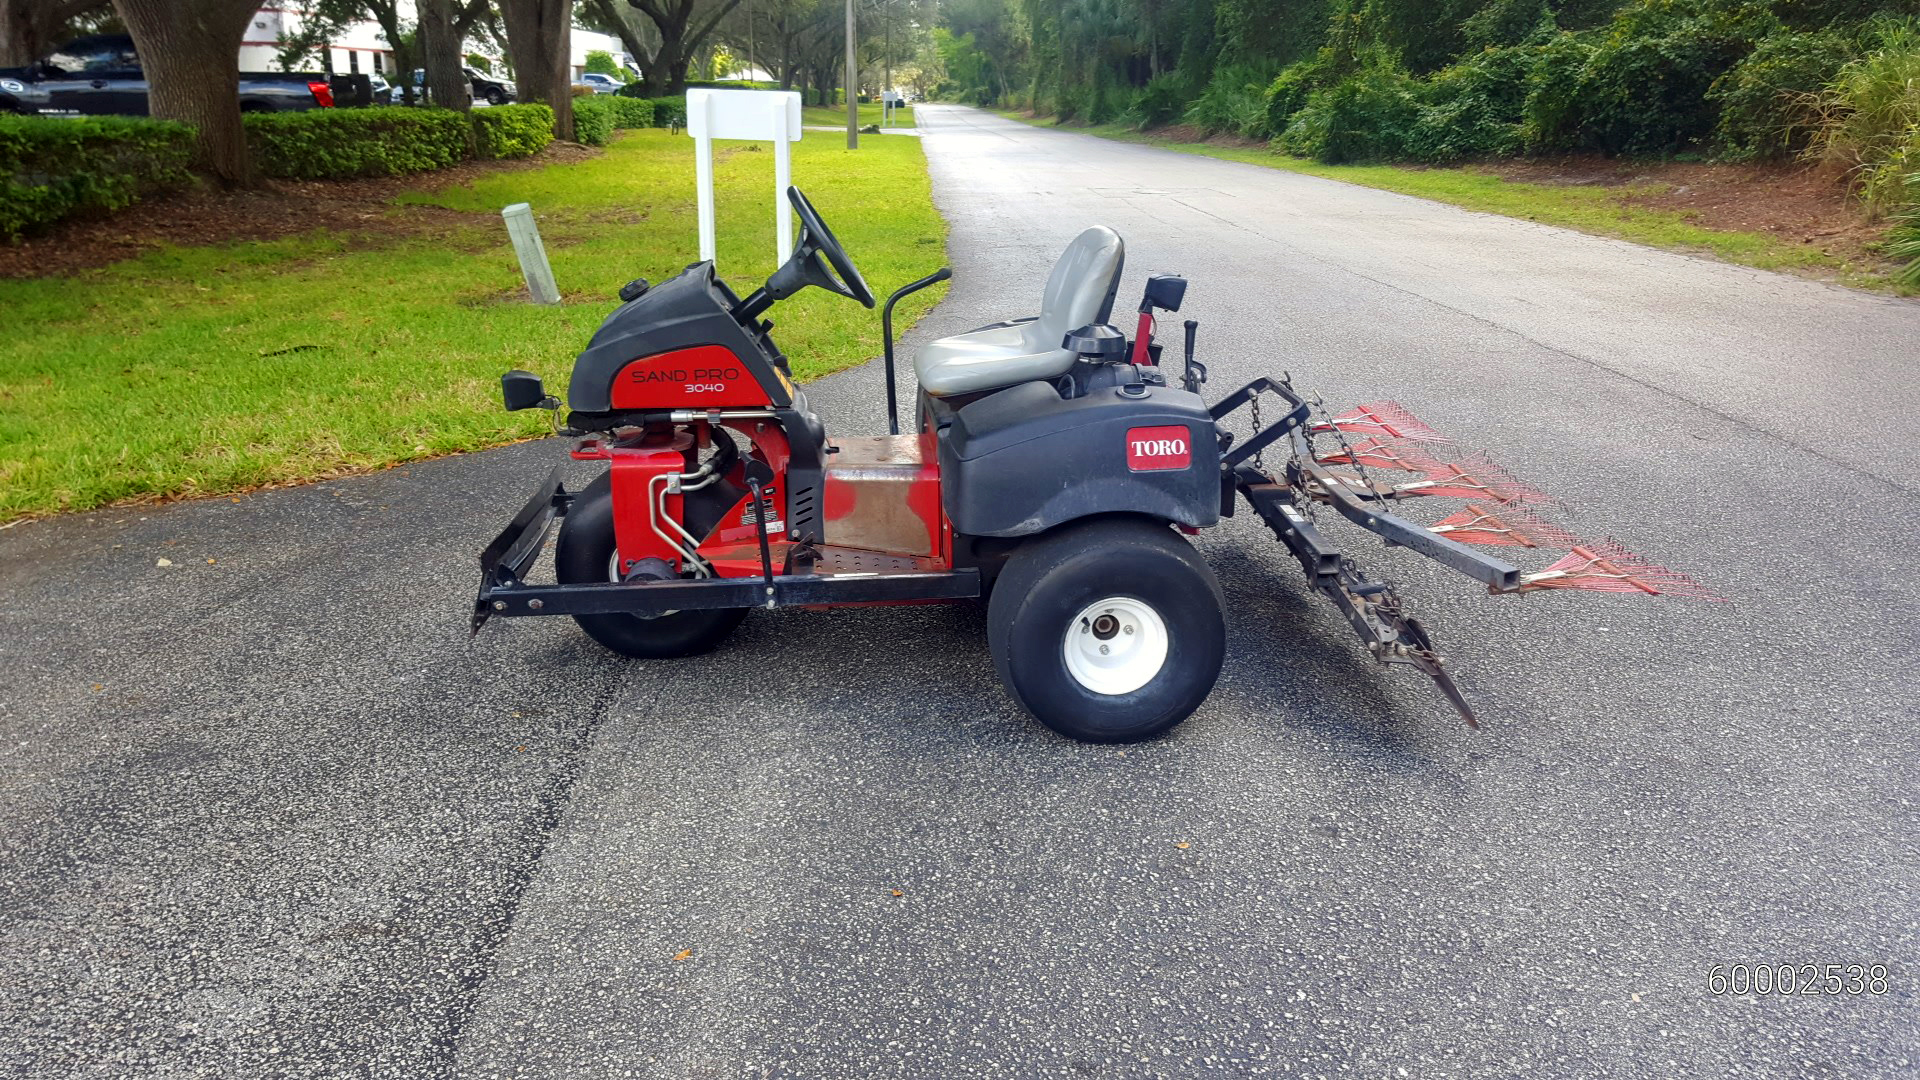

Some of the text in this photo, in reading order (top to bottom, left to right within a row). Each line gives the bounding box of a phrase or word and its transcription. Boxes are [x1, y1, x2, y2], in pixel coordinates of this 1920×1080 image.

[631, 368, 740, 383] SAND PRO
[684, 383, 725, 393] 3040
[1131, 439, 1185, 457] TORO
